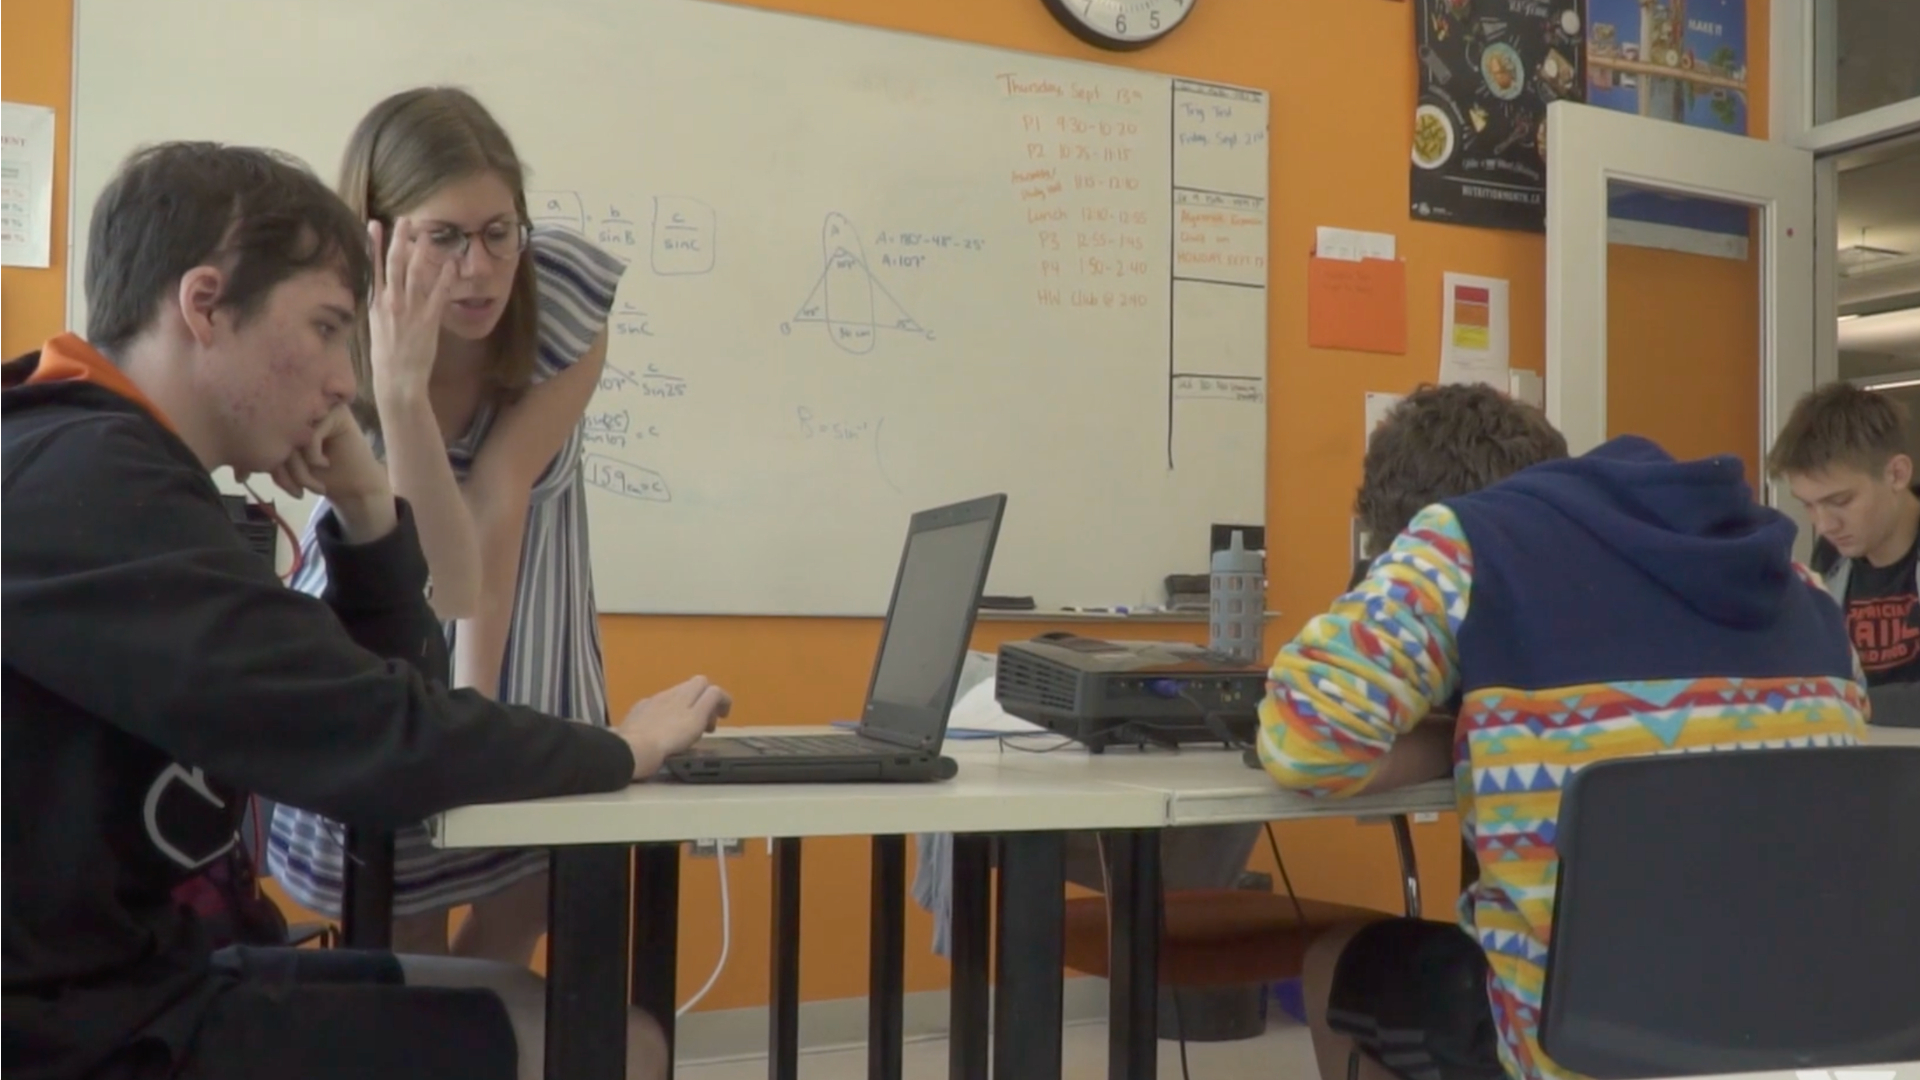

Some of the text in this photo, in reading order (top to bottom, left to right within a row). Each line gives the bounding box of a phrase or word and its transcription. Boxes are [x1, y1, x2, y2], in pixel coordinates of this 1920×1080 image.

[1115, 14, 1127, 34] 6
[1149, 11, 1160, 30] 5
[1022, 114, 1041, 132] P1
[1027, 143, 1044, 159] P2
[609, 204, 621, 218] b
[1027, 207, 1068, 224] Lunch
[1039, 230, 1060, 251] P3
